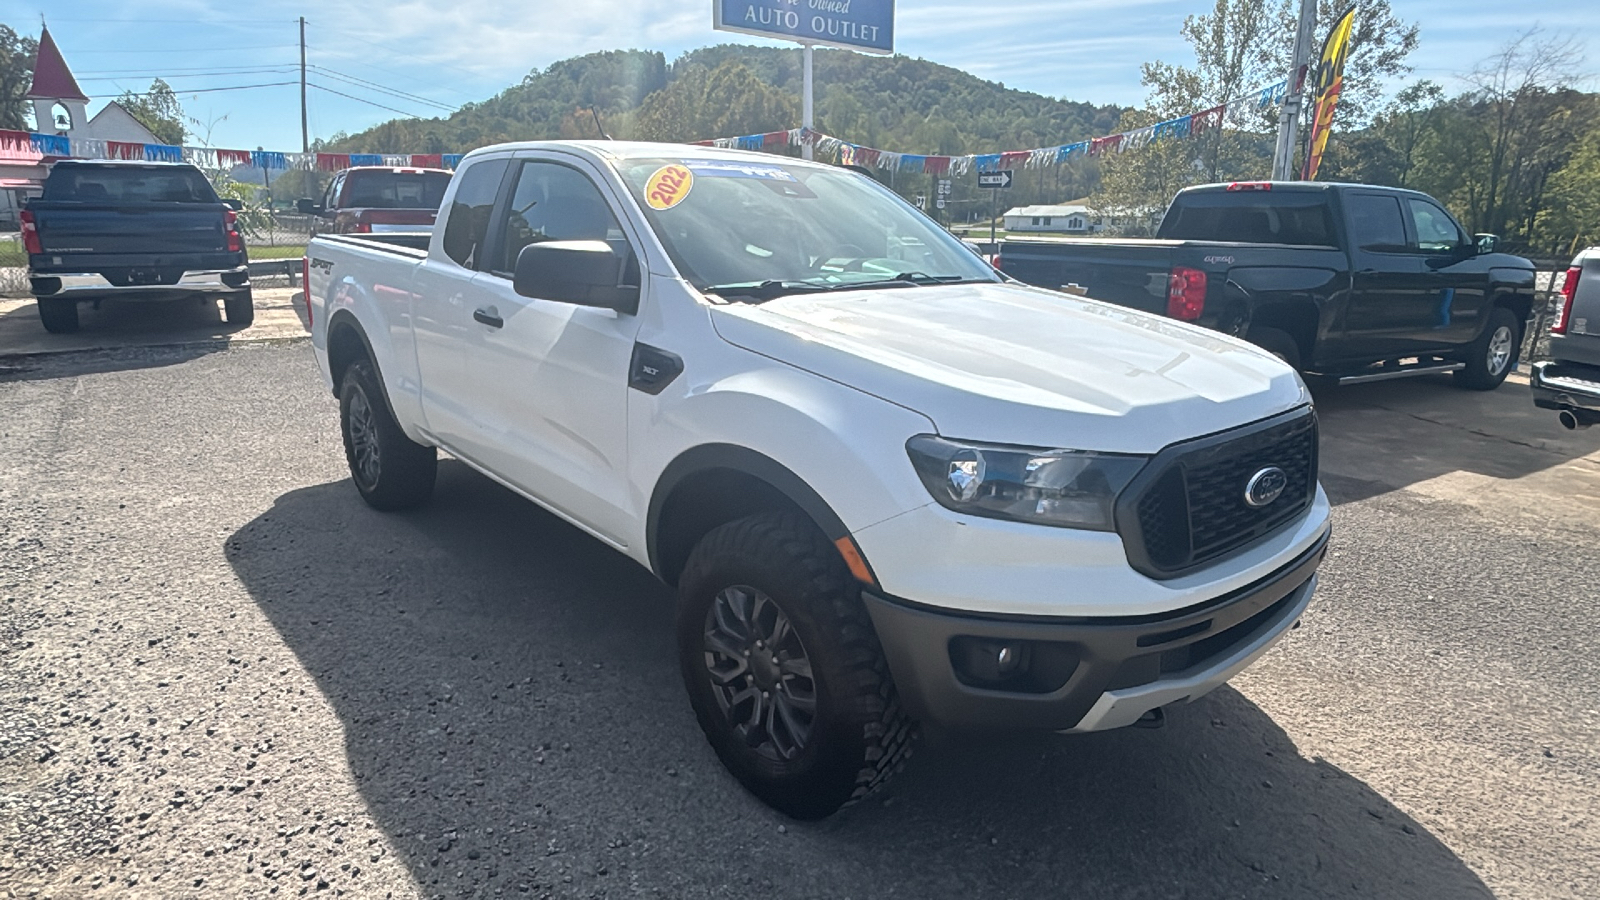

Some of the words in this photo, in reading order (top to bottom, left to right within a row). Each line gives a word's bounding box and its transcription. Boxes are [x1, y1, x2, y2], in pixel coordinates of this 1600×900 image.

[808, 0, 850, 14] Owned
[745, 5, 799, 29] AUTO
[811, 16, 879, 42] OUTLET
[651, 166, 687, 206] 2022
[310, 257, 335, 271] SPORT
[643, 365, 659, 376] XLT
